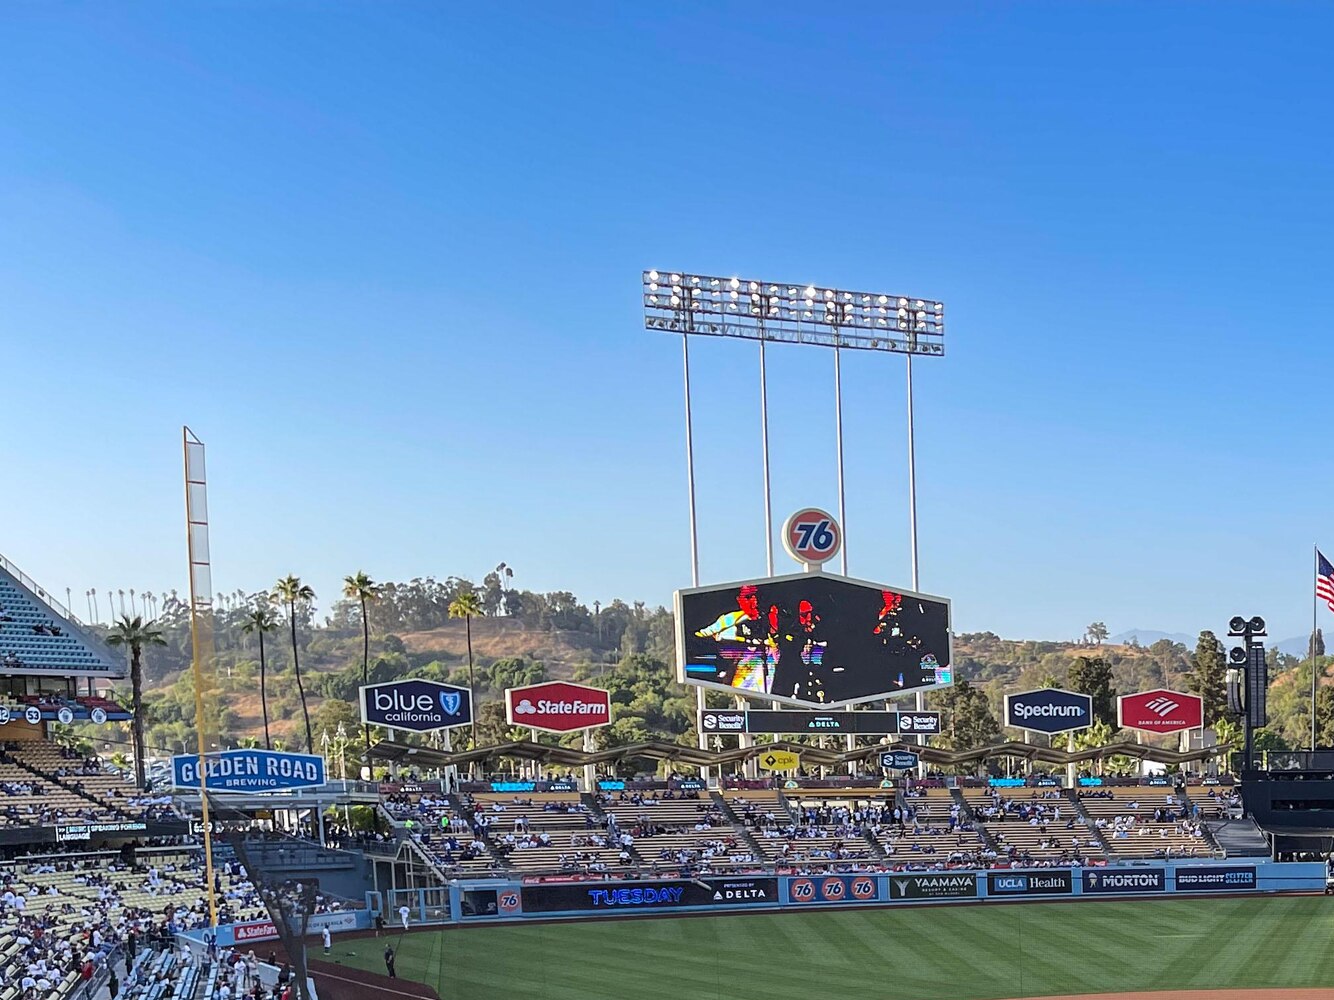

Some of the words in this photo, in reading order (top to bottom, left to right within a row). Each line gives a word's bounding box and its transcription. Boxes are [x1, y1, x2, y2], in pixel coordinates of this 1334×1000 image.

[794, 519, 835, 551] 76
[374, 688, 434, 711] blue
[27, 710, 39, 720] 53
[385, 711, 441, 722] california
[1014, 702, 1080, 719] Spectrum
[718, 715, 745, 724] Security
[913, 715, 937, 724] Security
[777, 756, 795, 766] cpk
[181, 756, 259, 782] GOLDEN
[266, 756, 318, 781] ROAD
[226, 778, 277, 787] BREWING
[999, 878, 1023, 888] UCLA
[1030, 877, 1066, 888] Health
[1102, 874, 1158, 887] MORTON
[1178, 875, 1198, 883] BUD
[1199, 874, 1225, 883] LIGHT
[1225, 871, 1253, 884] SELTZER
[727, 889, 766, 900] DELTA
[795, 883, 812, 896] 76
[825, 882, 841, 895] 76
[855, 881, 871, 893] 76
[501, 895, 517, 907] 76
[588, 887, 685, 907] TUESDAY
